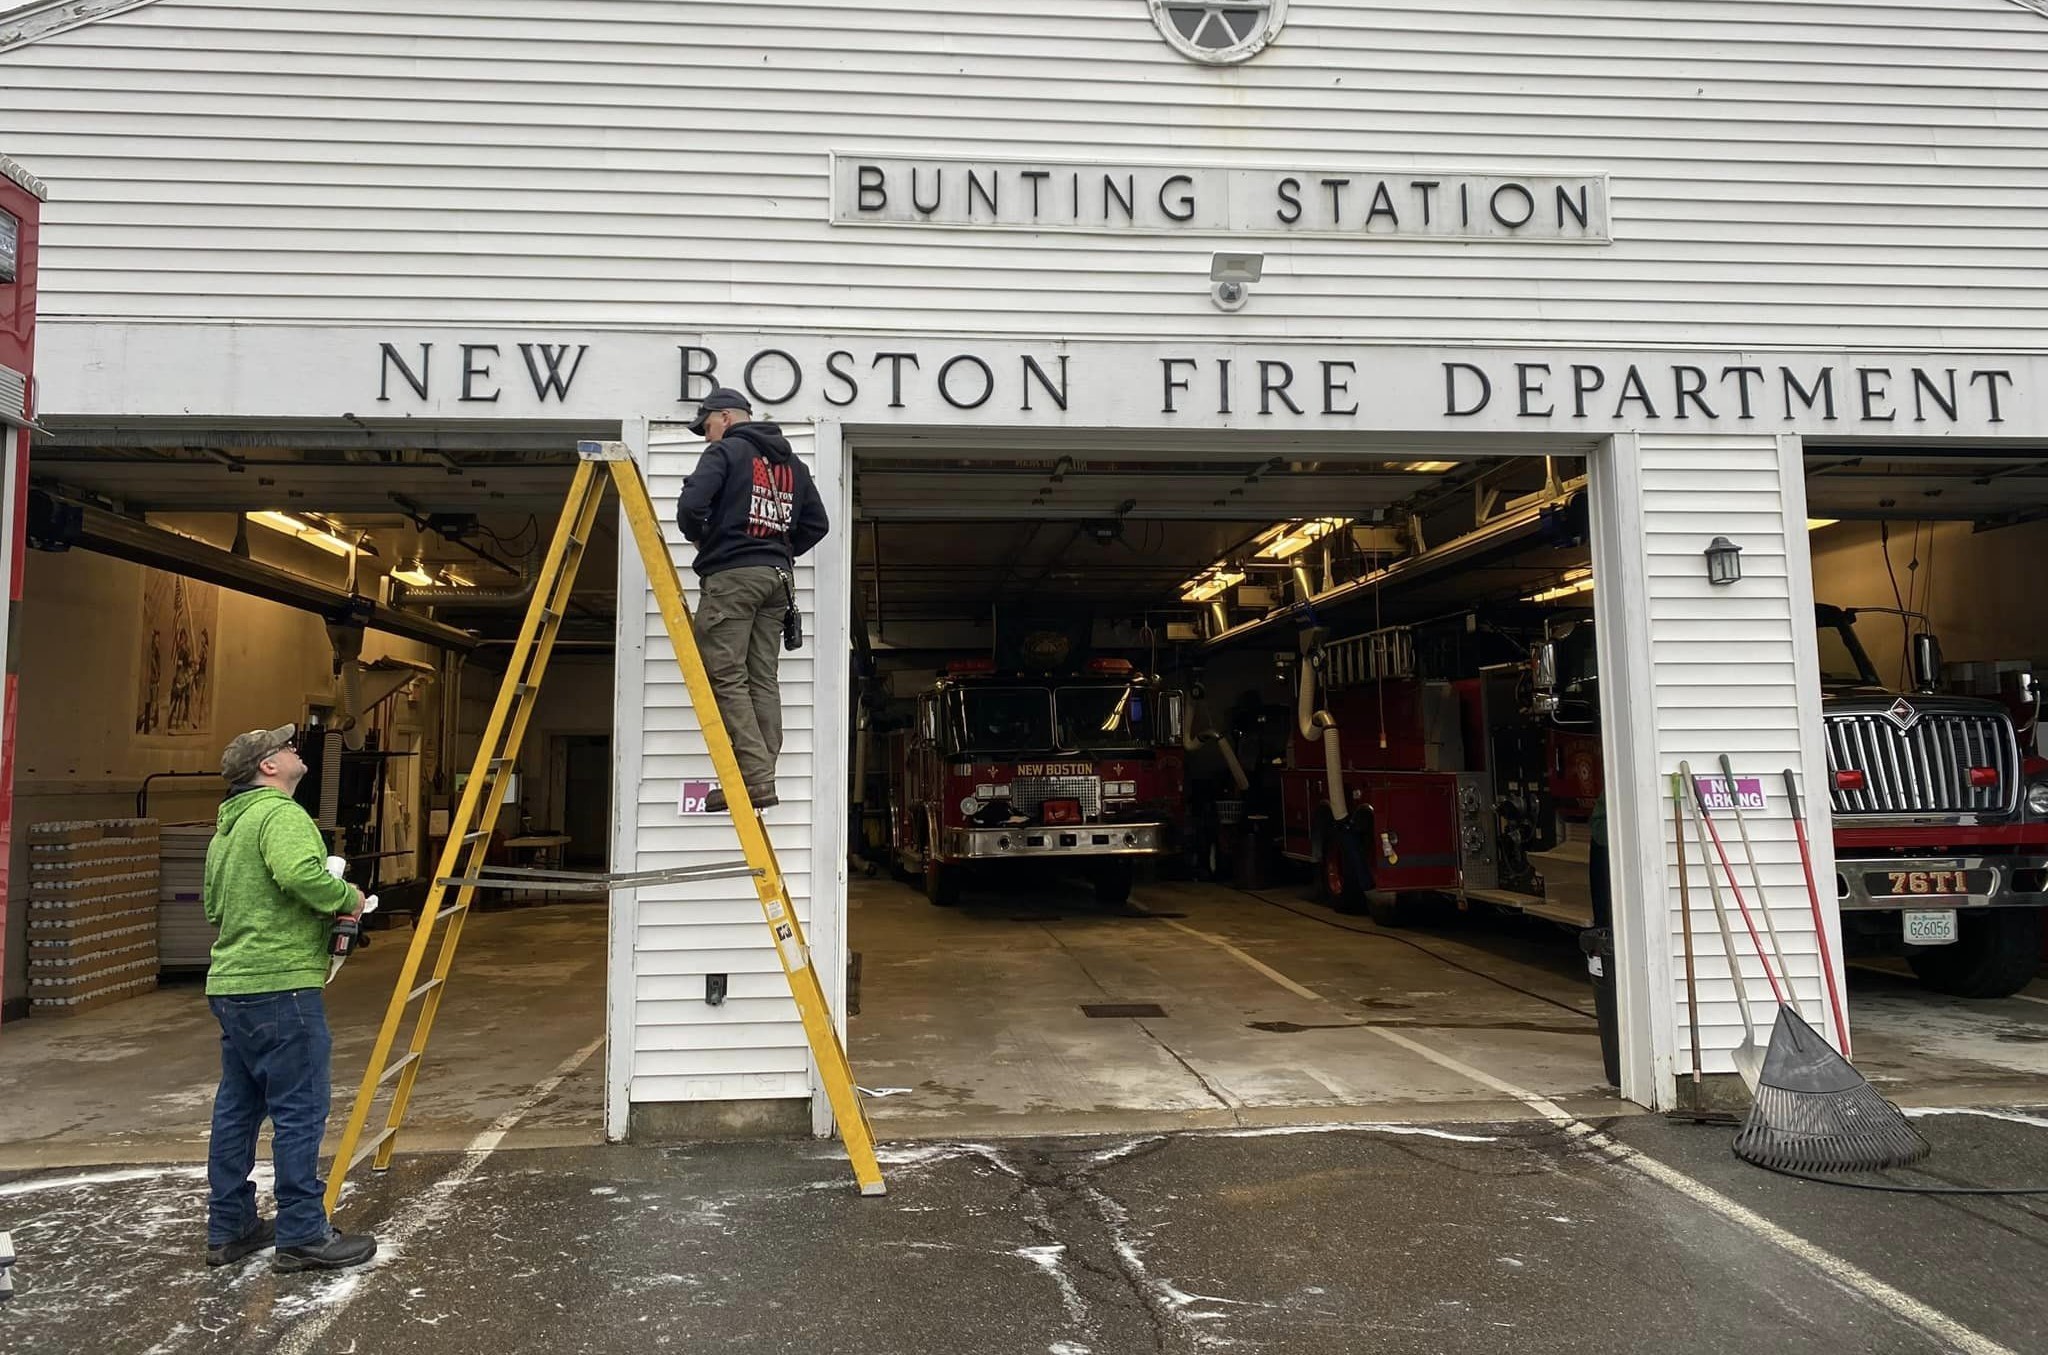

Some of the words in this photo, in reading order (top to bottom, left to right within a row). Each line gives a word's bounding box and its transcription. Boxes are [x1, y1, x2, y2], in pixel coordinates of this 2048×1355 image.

[857, 165, 1196, 220] BUNTING
[1276, 178, 1589, 229] STATION
[376, 343, 589, 402] NEW
[677, 345, 1070, 411] BOSTON
[1159, 358, 1360, 415] FIRE
[1443, 362, 2013, 423] DEPARTMENT
[1017, 764, 1043, 776] NEW
[1046, 763, 1093, 775] BOSTON
[1703, 793, 1761, 807] ARKNG
[1889, 872, 1967, 893] 76T1
[1911, 921, 1951, 936] G26056
